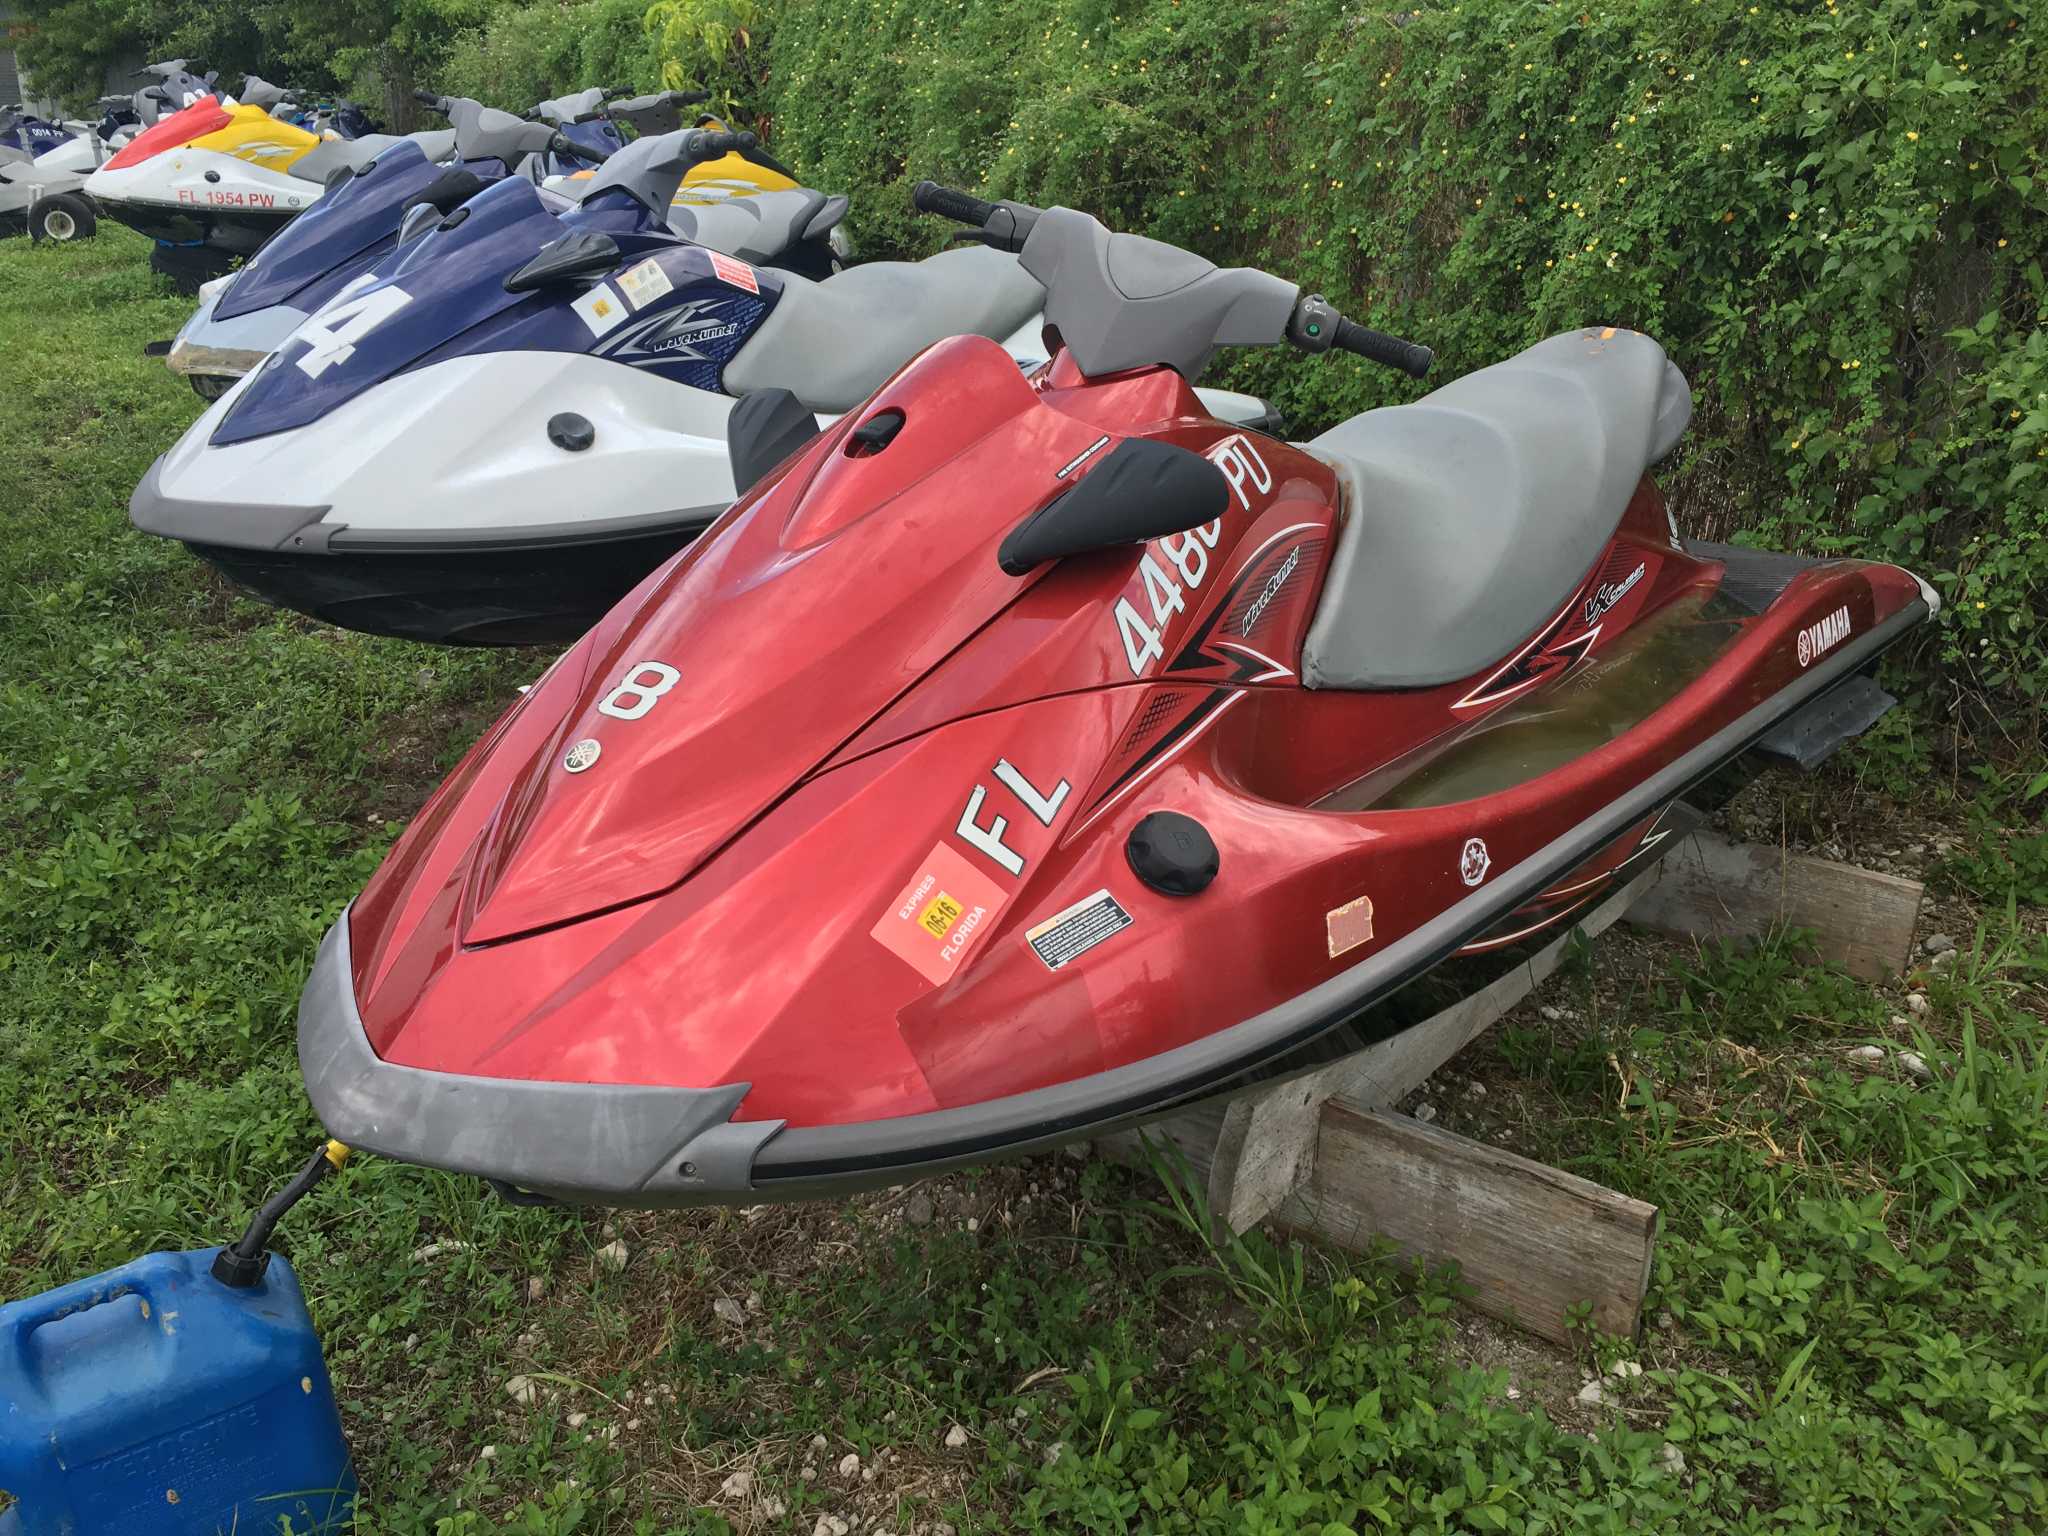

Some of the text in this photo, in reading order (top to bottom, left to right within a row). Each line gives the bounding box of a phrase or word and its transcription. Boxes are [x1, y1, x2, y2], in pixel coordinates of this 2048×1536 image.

[178, 190, 274, 208] FL 1954 PW
[955, 757, 1072, 879] FL
[1213, 433, 1273, 512] PU
[1808, 605, 1851, 658] YAMAHA
[598, 660, 681, 720] 8
[898, 874, 936, 920] EXPIRES
[926, 901, 958, 935] 06-16
[940, 905, 987, 961] FLORIDA
